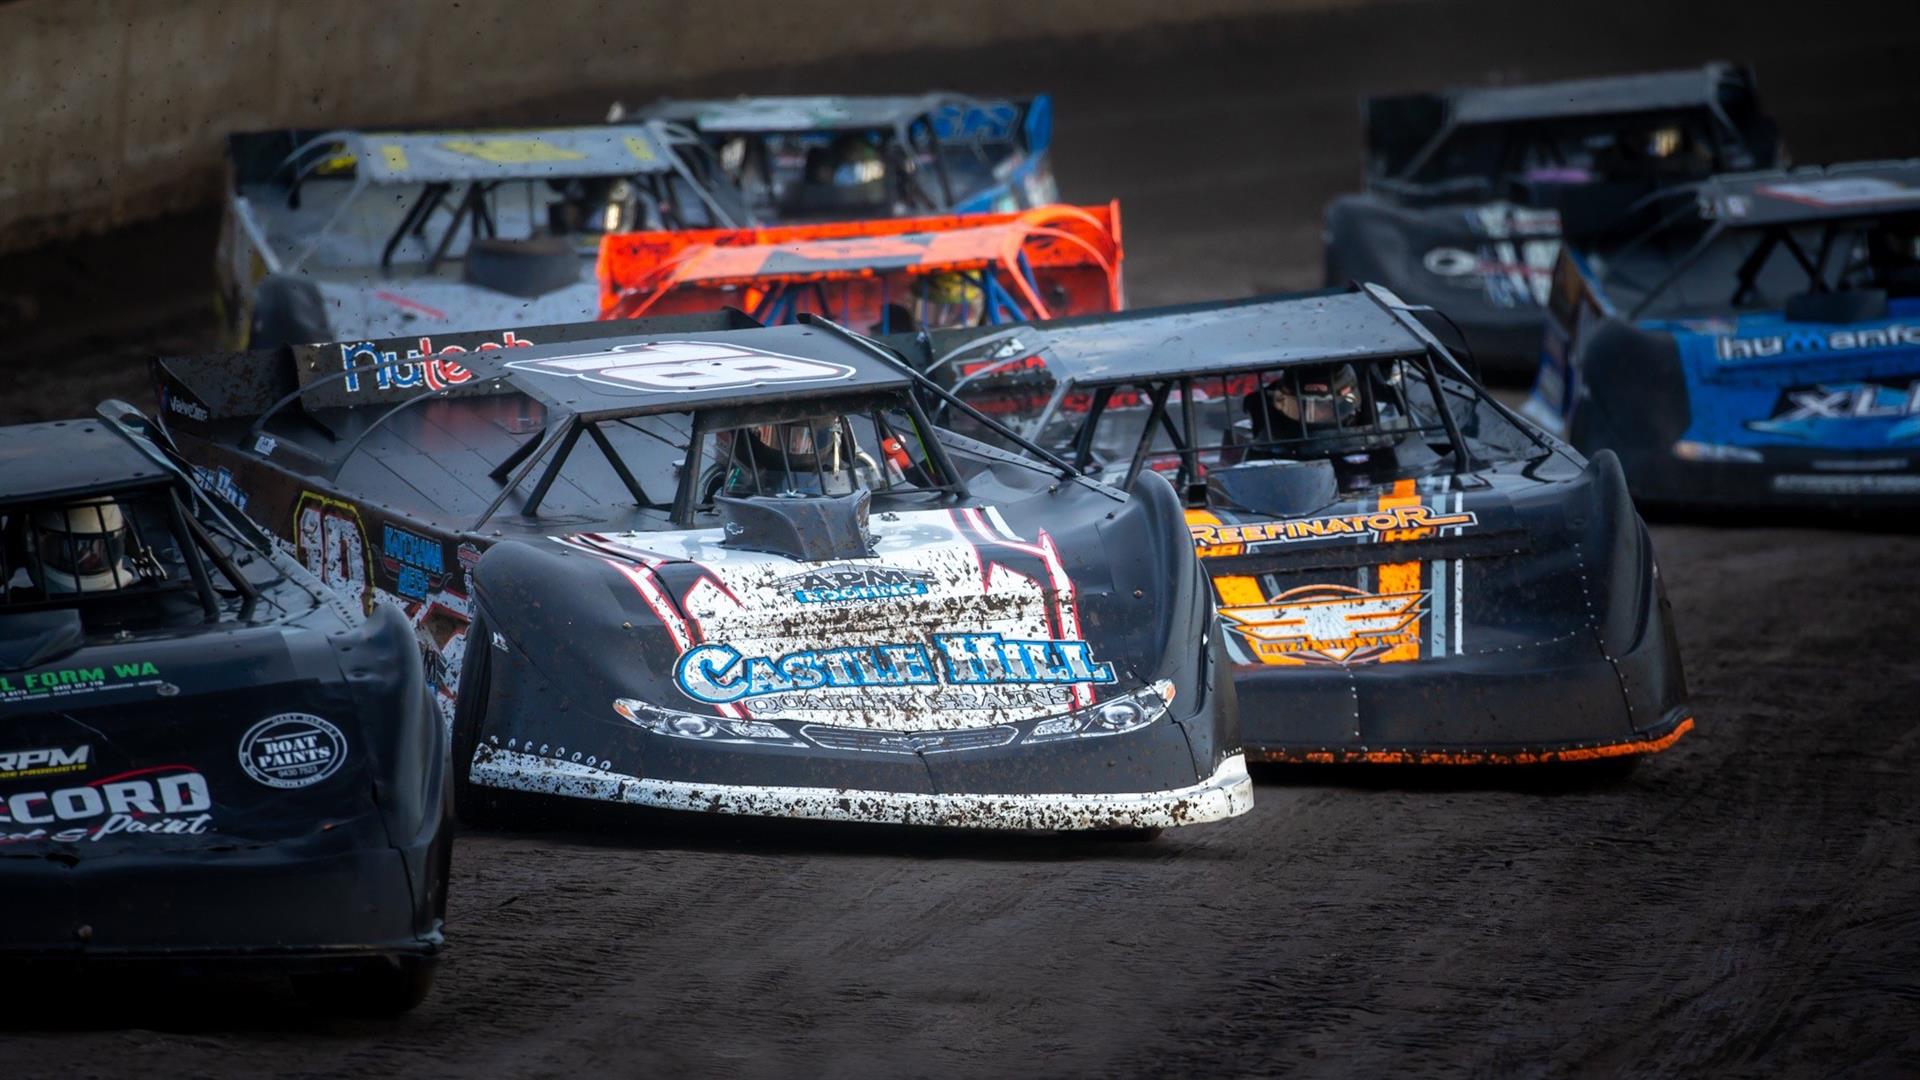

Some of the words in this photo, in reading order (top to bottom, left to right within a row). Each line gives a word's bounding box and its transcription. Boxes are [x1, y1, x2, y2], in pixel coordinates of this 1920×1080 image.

[340, 331, 534, 393] nute
[1190, 508, 1474, 544] REEFINATOR
[24, 667, 106, 689] FORM
[112, 661, 160, 679] WA
[675, 642, 937, 703] CASTLE
[933, 633, 1118, 686] HILL
[0, 744, 90, 771] RPM
[257, 746, 332, 768] PAINTS
[264, 735, 318, 755] BOAT
